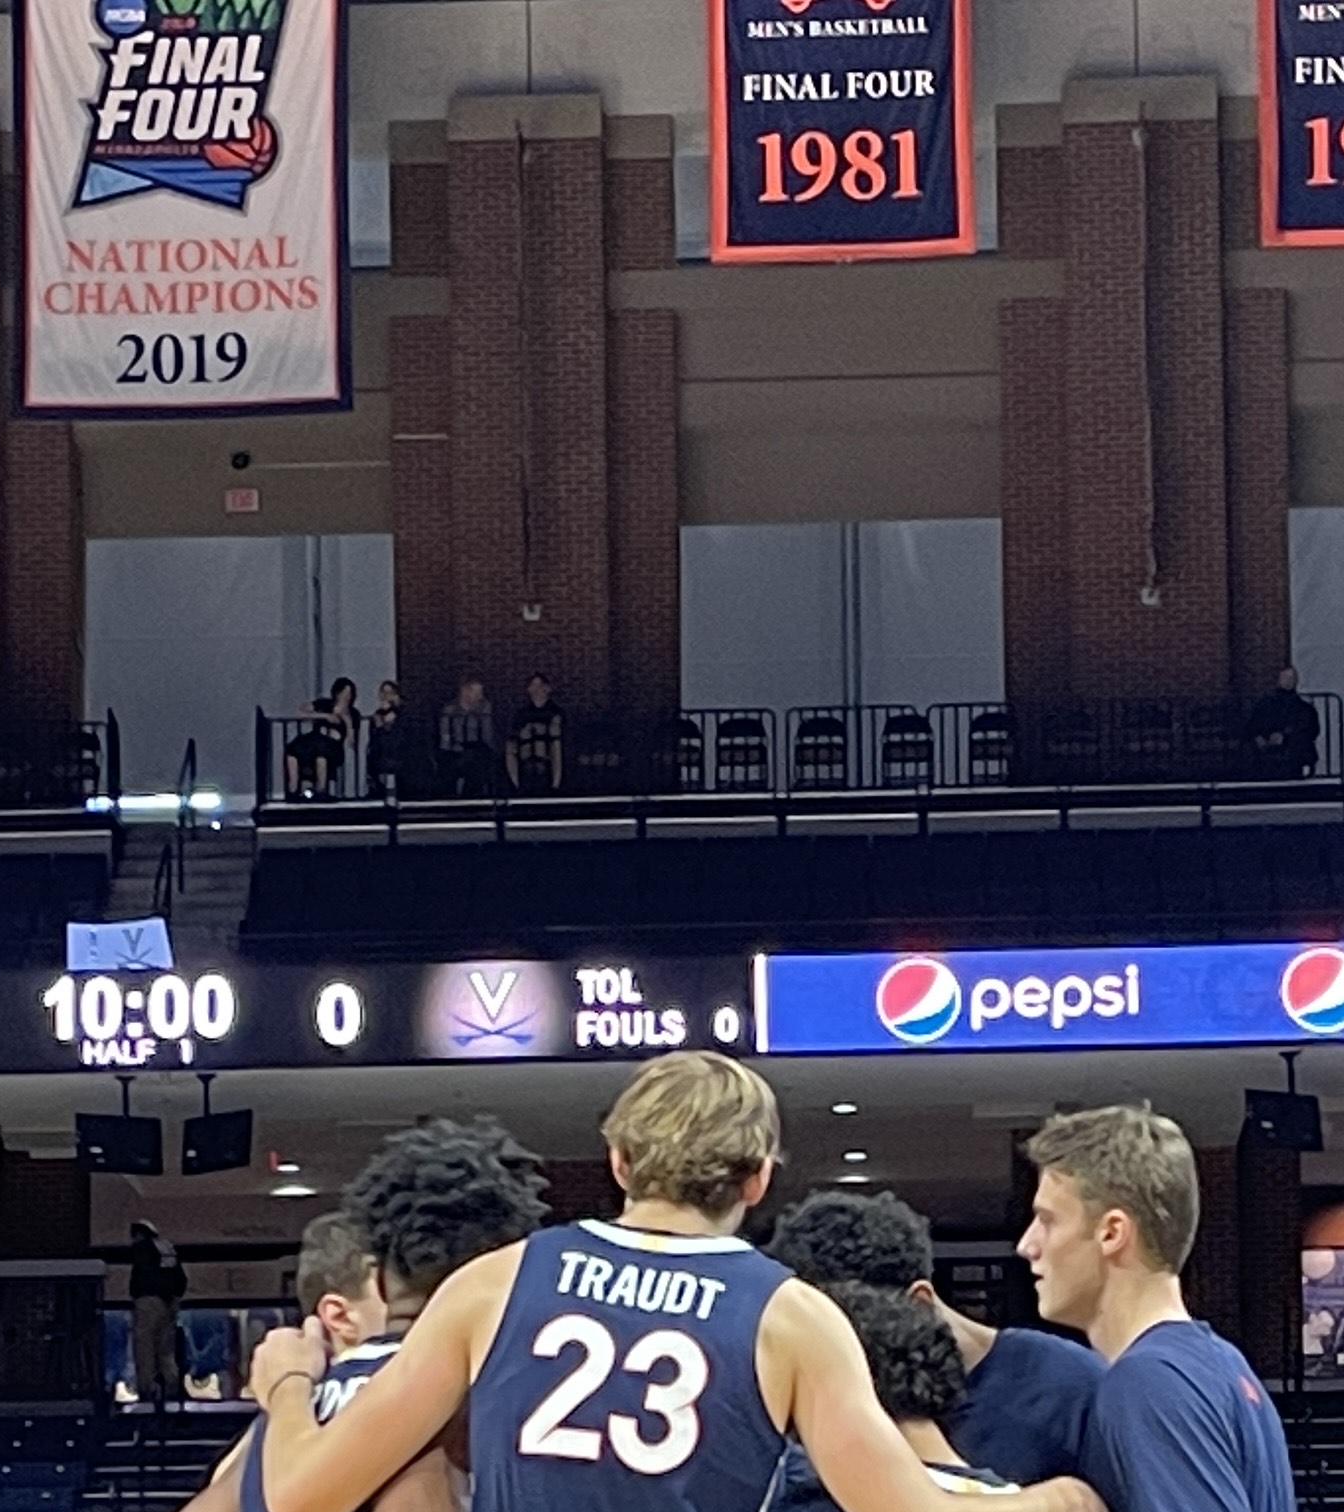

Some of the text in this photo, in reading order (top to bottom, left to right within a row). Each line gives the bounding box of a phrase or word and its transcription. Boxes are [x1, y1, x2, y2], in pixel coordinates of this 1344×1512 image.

[108, 31, 266, 88] FINAL
[742, 69, 936, 102] FINAL FOUR
[96, 86, 259, 142] FOUR
[756, 128, 925, 204] 1981
[66, 235, 299, 274] NATIONAL
[43, 275, 321, 318] CHAMPIONS
[115, 331, 248, 385] 2019
[42, 974, 235, 1041] 10:00
[576, 968, 643, 1004] TOL
[969, 964, 1141, 1029] pepsi
[315, 983, 362, 1047] 0
[576, 1005, 742, 1047] FOULS 0
[81, 1038, 194, 1065] HALF 1
[555, 1250, 728, 1321] TRAUDT
[517, 1312, 710, 1476] 23
